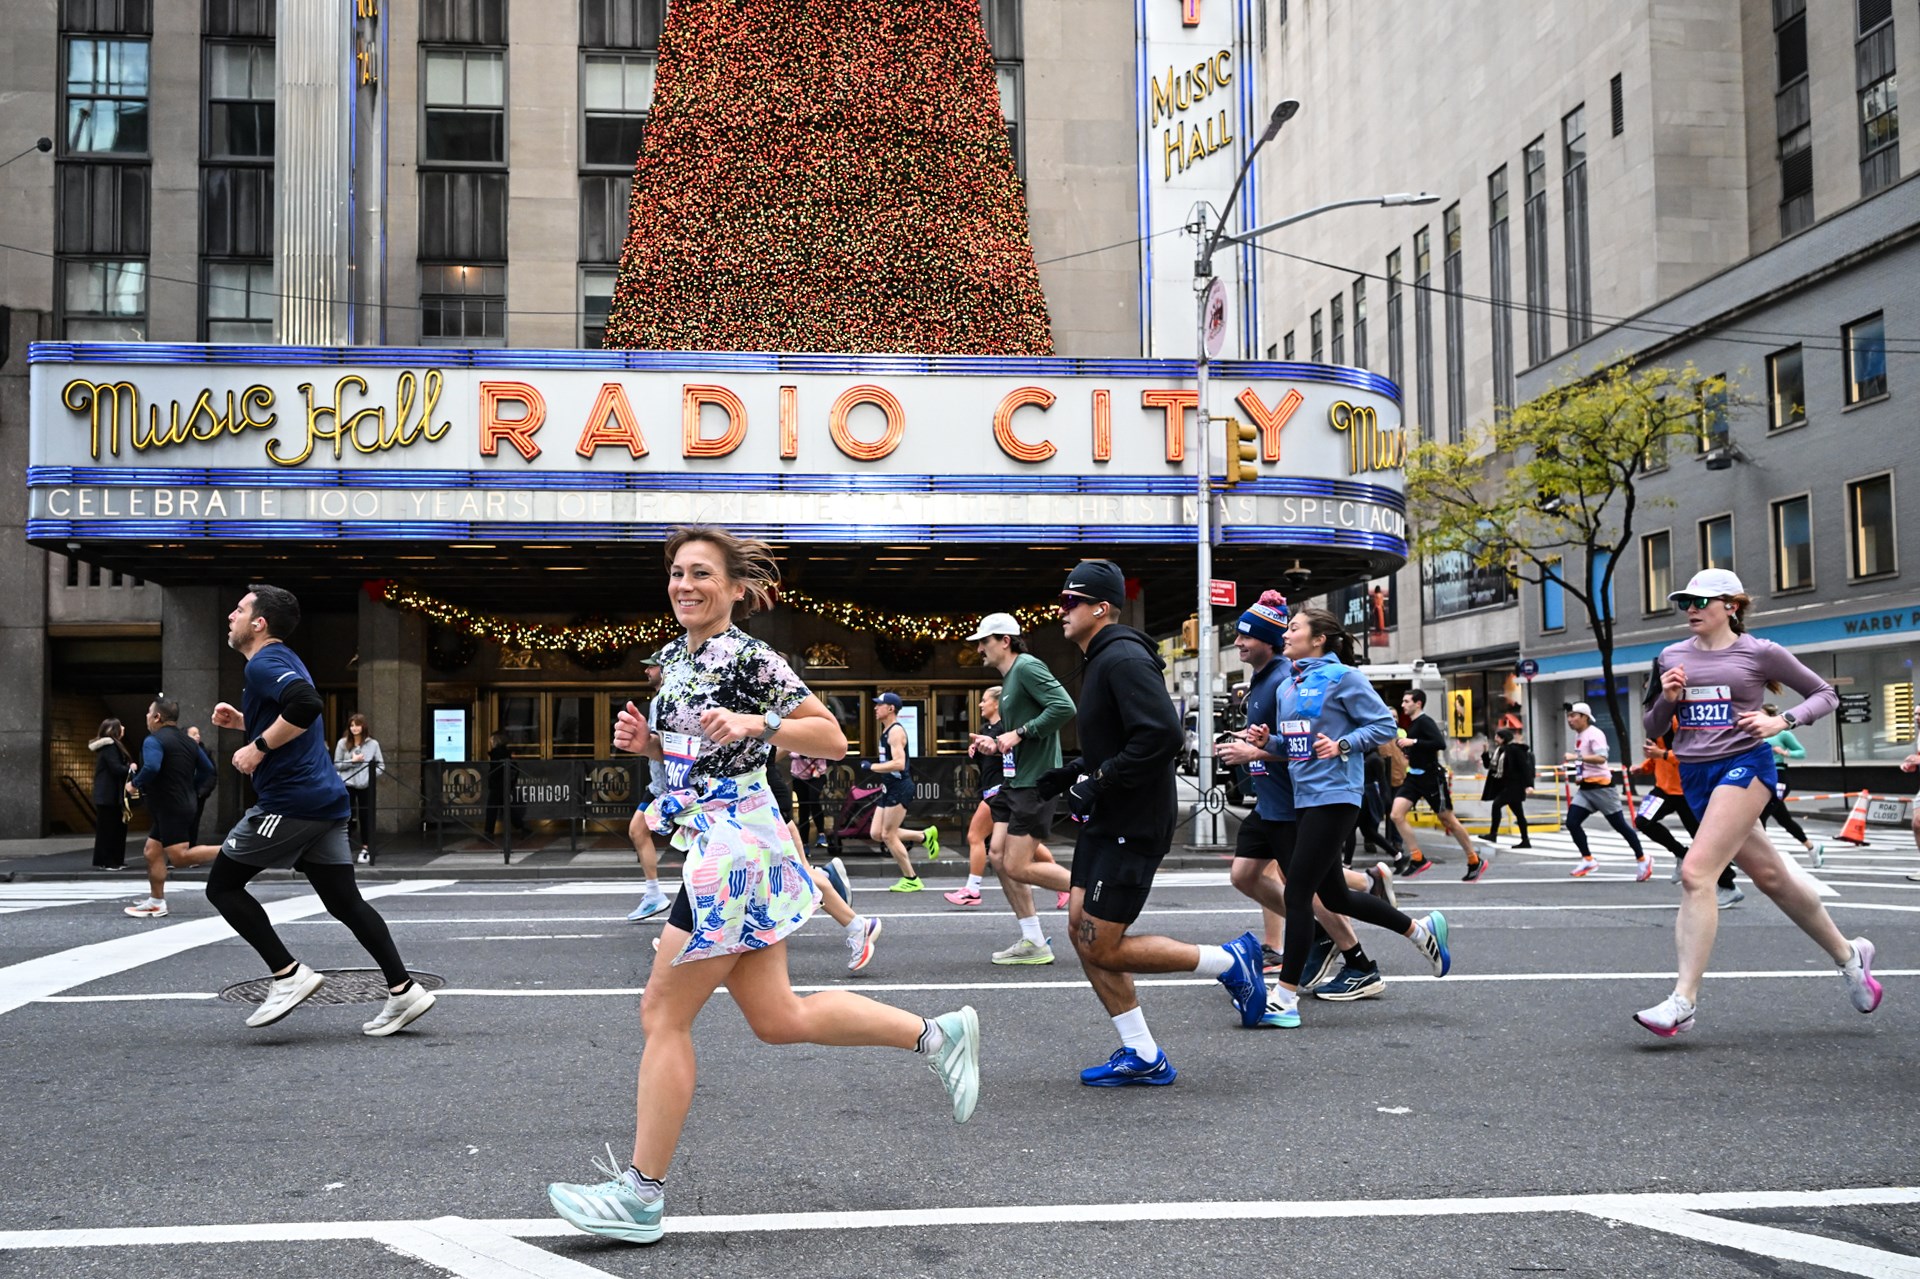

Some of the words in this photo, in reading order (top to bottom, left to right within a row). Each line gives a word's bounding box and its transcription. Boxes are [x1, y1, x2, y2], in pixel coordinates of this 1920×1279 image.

[1152, 50, 1232, 128] MUSIC
[1164, 109, 1233, 182] HALL
[62, 378, 277, 459] Music
[265, 368, 452, 466] Hall
[478, 380, 906, 462] RADIO
[992, 384, 1305, 463] CITY
[48, 488, 277, 518] CELEBRATE
[310, 490, 379, 517] 100
[411, 491, 529, 518] YEARS
[558, 492, 609, 521] OF
[1054, 495, 1254, 524] CHRISTMAS
[1843, 613, 1903, 634] WARBY
[1689, 703, 1729, 722] 13217
[1288, 736, 1308, 753] 3637
[1873, 812, 1898, 820] CLOSED
[1879, 803, 1897, 811] ROAD
